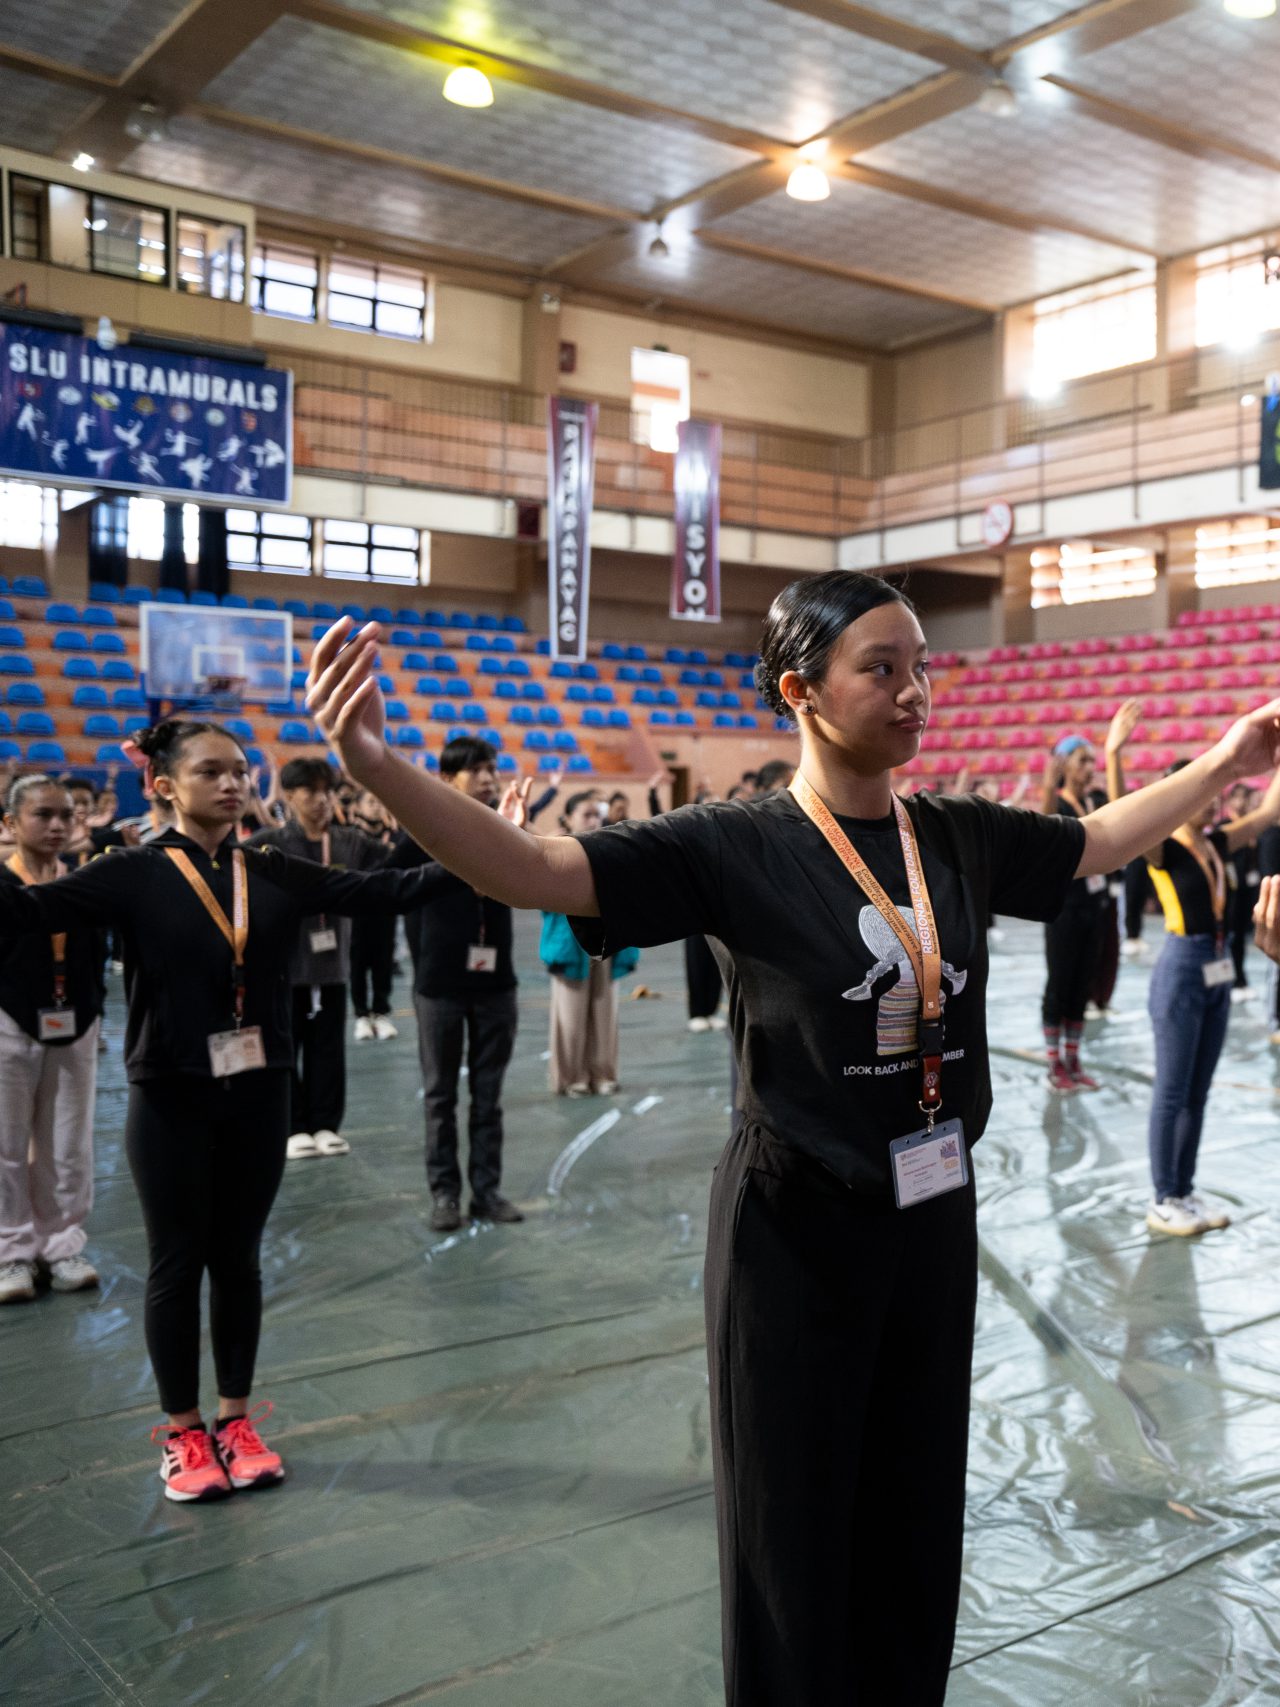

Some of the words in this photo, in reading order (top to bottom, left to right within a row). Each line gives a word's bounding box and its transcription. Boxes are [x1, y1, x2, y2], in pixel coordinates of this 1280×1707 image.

[9, 343, 68, 379] SLU
[80, 354, 279, 412] INTRAMURALS
[900, 831, 915, 868] DANCE
[853, 869, 873, 894] Baguio
[869, 892, 883, 907] City
[880, 906, 903, 934] Chapter
[860, 867, 887, 901] Cordillera
[884, 900, 919, 950] Administrative
[908, 866, 921, 895] FOLK
[914, 897, 933, 954] REGIONAL
[844, 1066, 872, 1075] LOOK
[875, 1063, 899, 1075] BACK
[900, 1059, 918, 1071] AND
[942, 1049, 965, 1062] MBER
